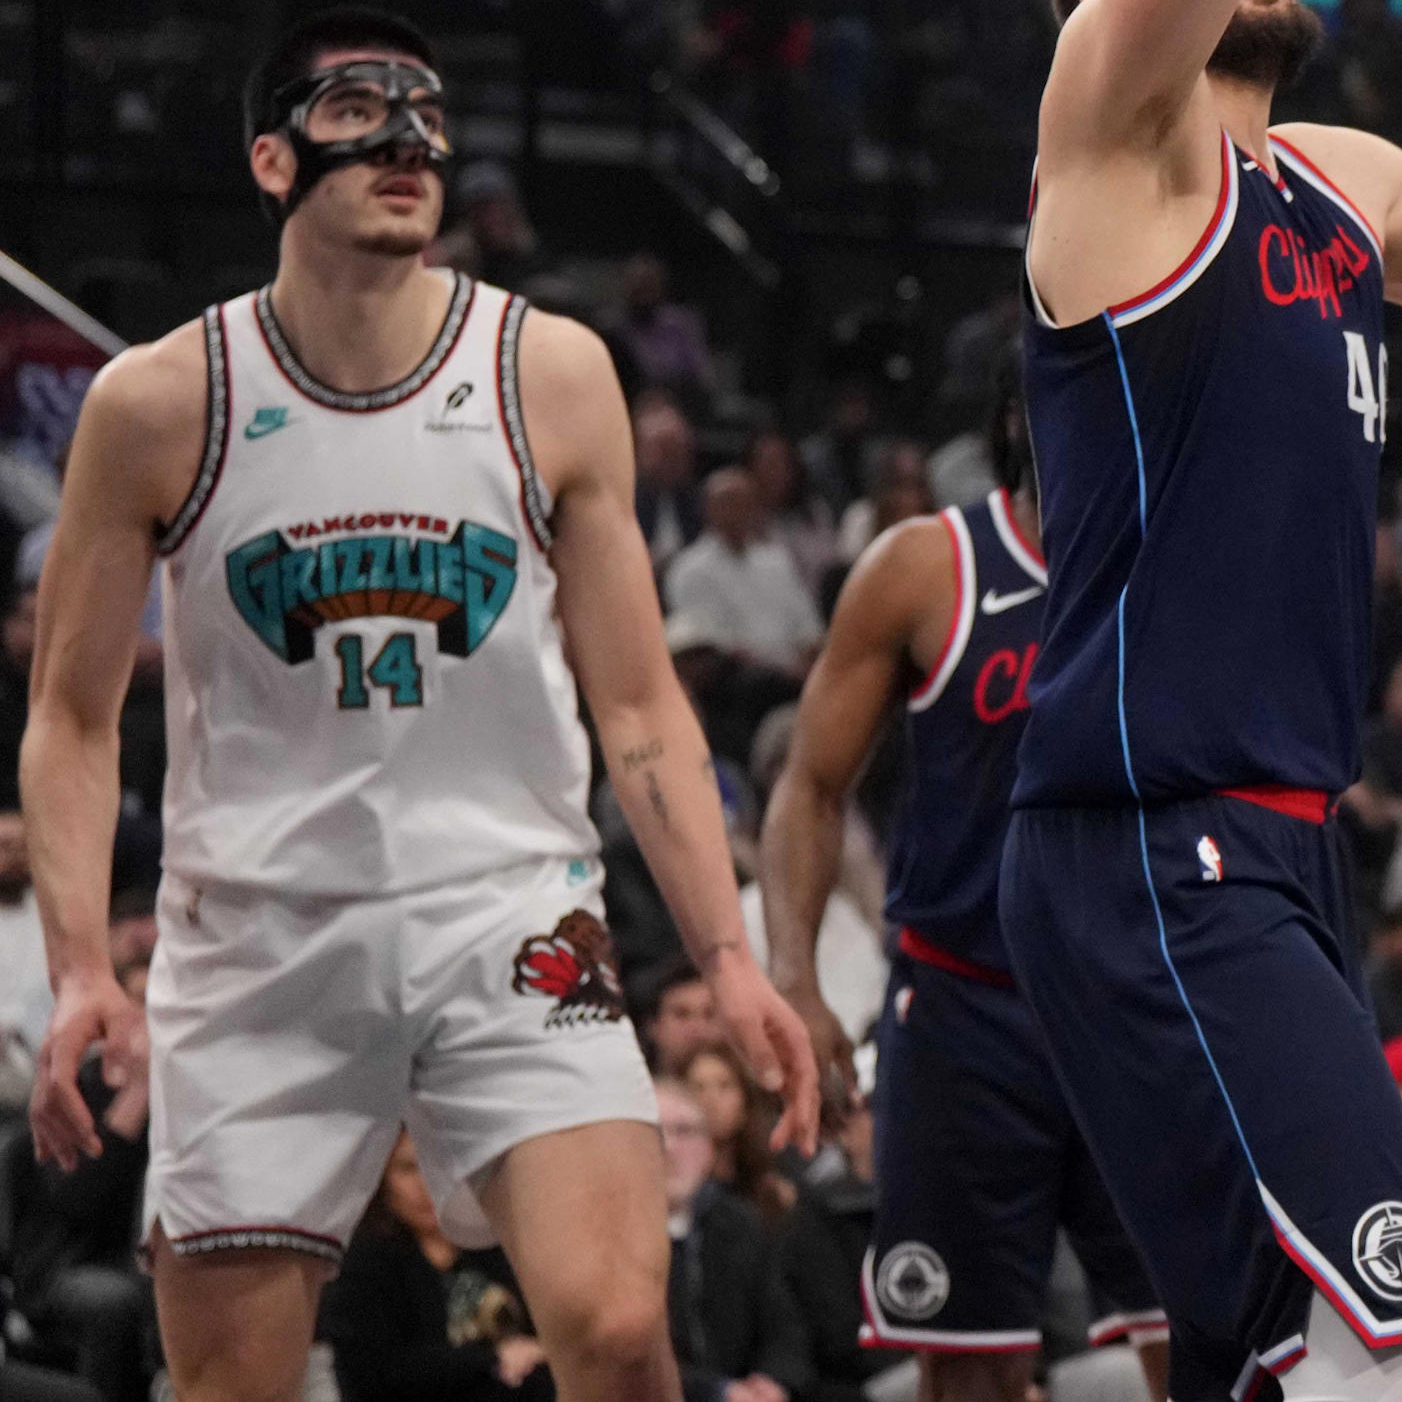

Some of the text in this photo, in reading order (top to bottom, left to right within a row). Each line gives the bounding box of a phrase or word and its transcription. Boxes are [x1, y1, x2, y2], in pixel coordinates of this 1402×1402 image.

[288, 512, 449, 541] VANCOUVER
[226, 519, 518, 667] GRIZZLIES
[334, 631, 424, 710] 14
